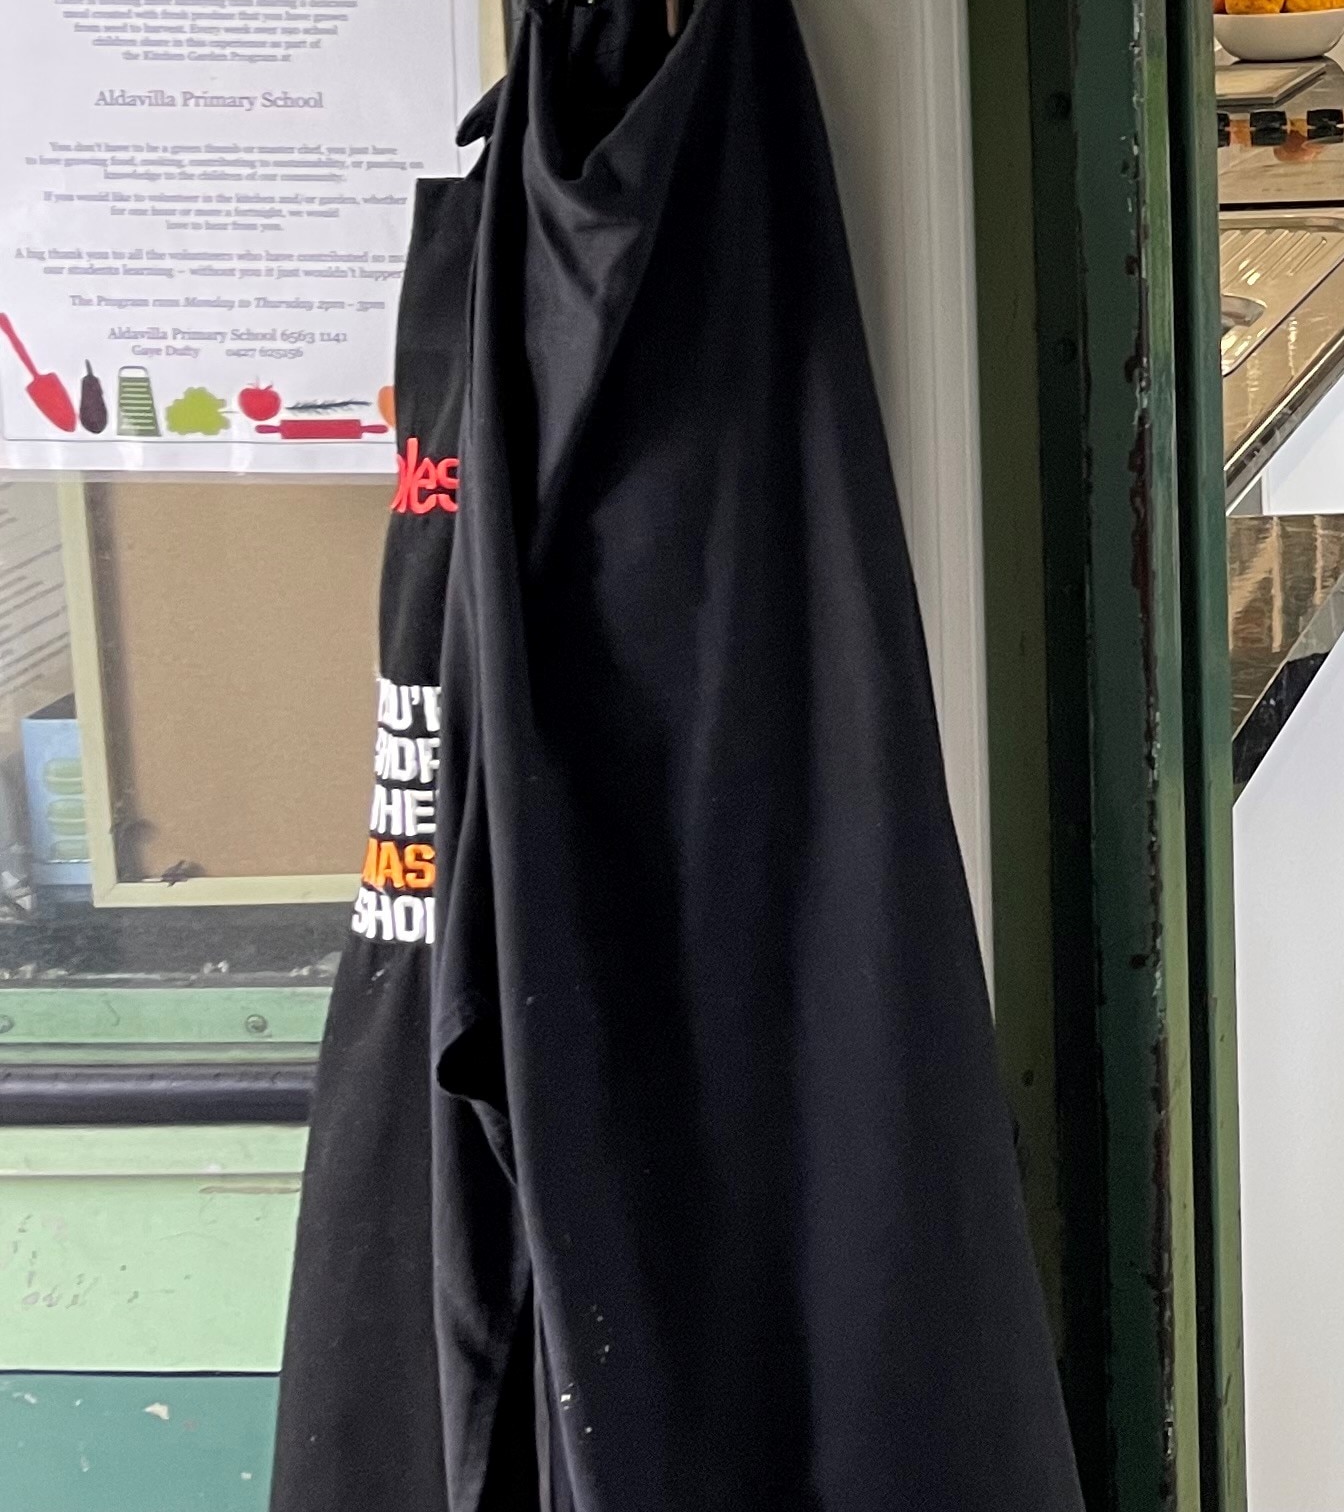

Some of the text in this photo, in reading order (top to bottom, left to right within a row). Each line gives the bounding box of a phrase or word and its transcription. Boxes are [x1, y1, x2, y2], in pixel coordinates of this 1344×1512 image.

[95, 89, 324, 111] Aldavilla Primary School
